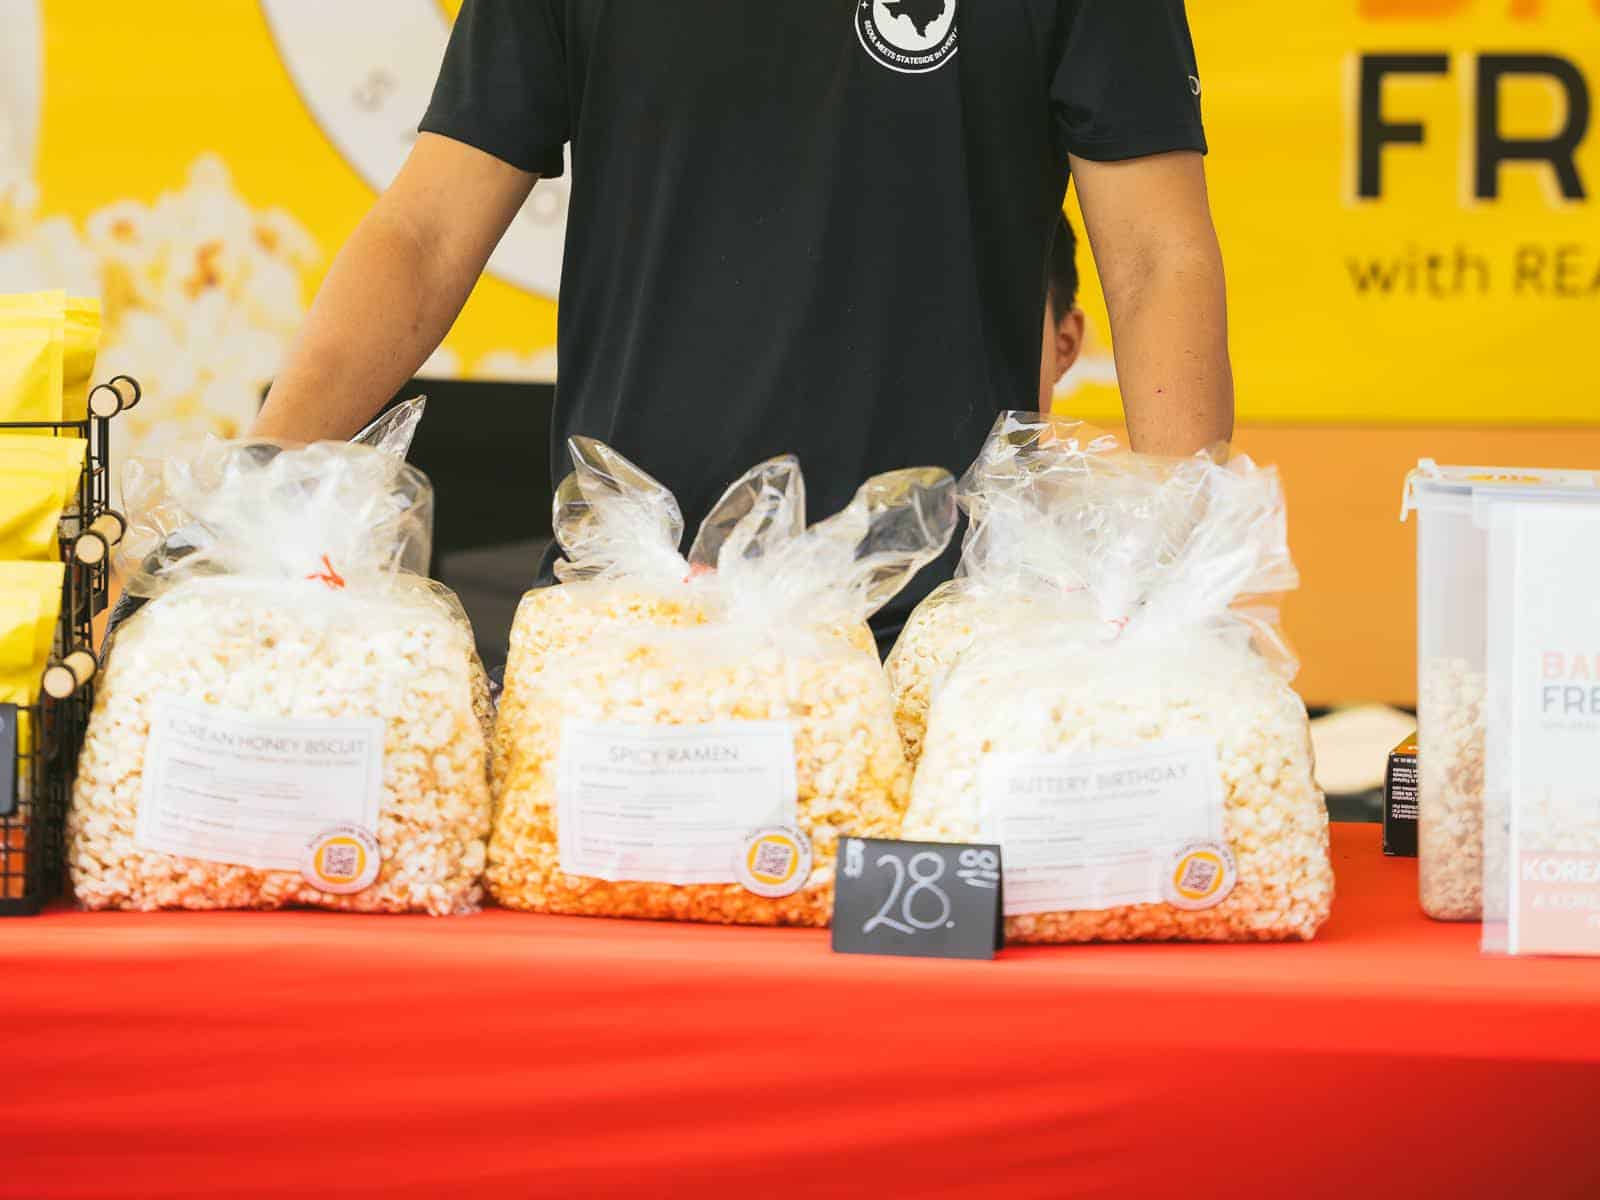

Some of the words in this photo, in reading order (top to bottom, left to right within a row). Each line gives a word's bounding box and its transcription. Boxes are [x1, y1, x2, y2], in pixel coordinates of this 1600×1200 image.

[1346, 52, 1592, 204] FR
[1346, 243, 1490, 297] with
[1541, 650, 1600, 681] BA
